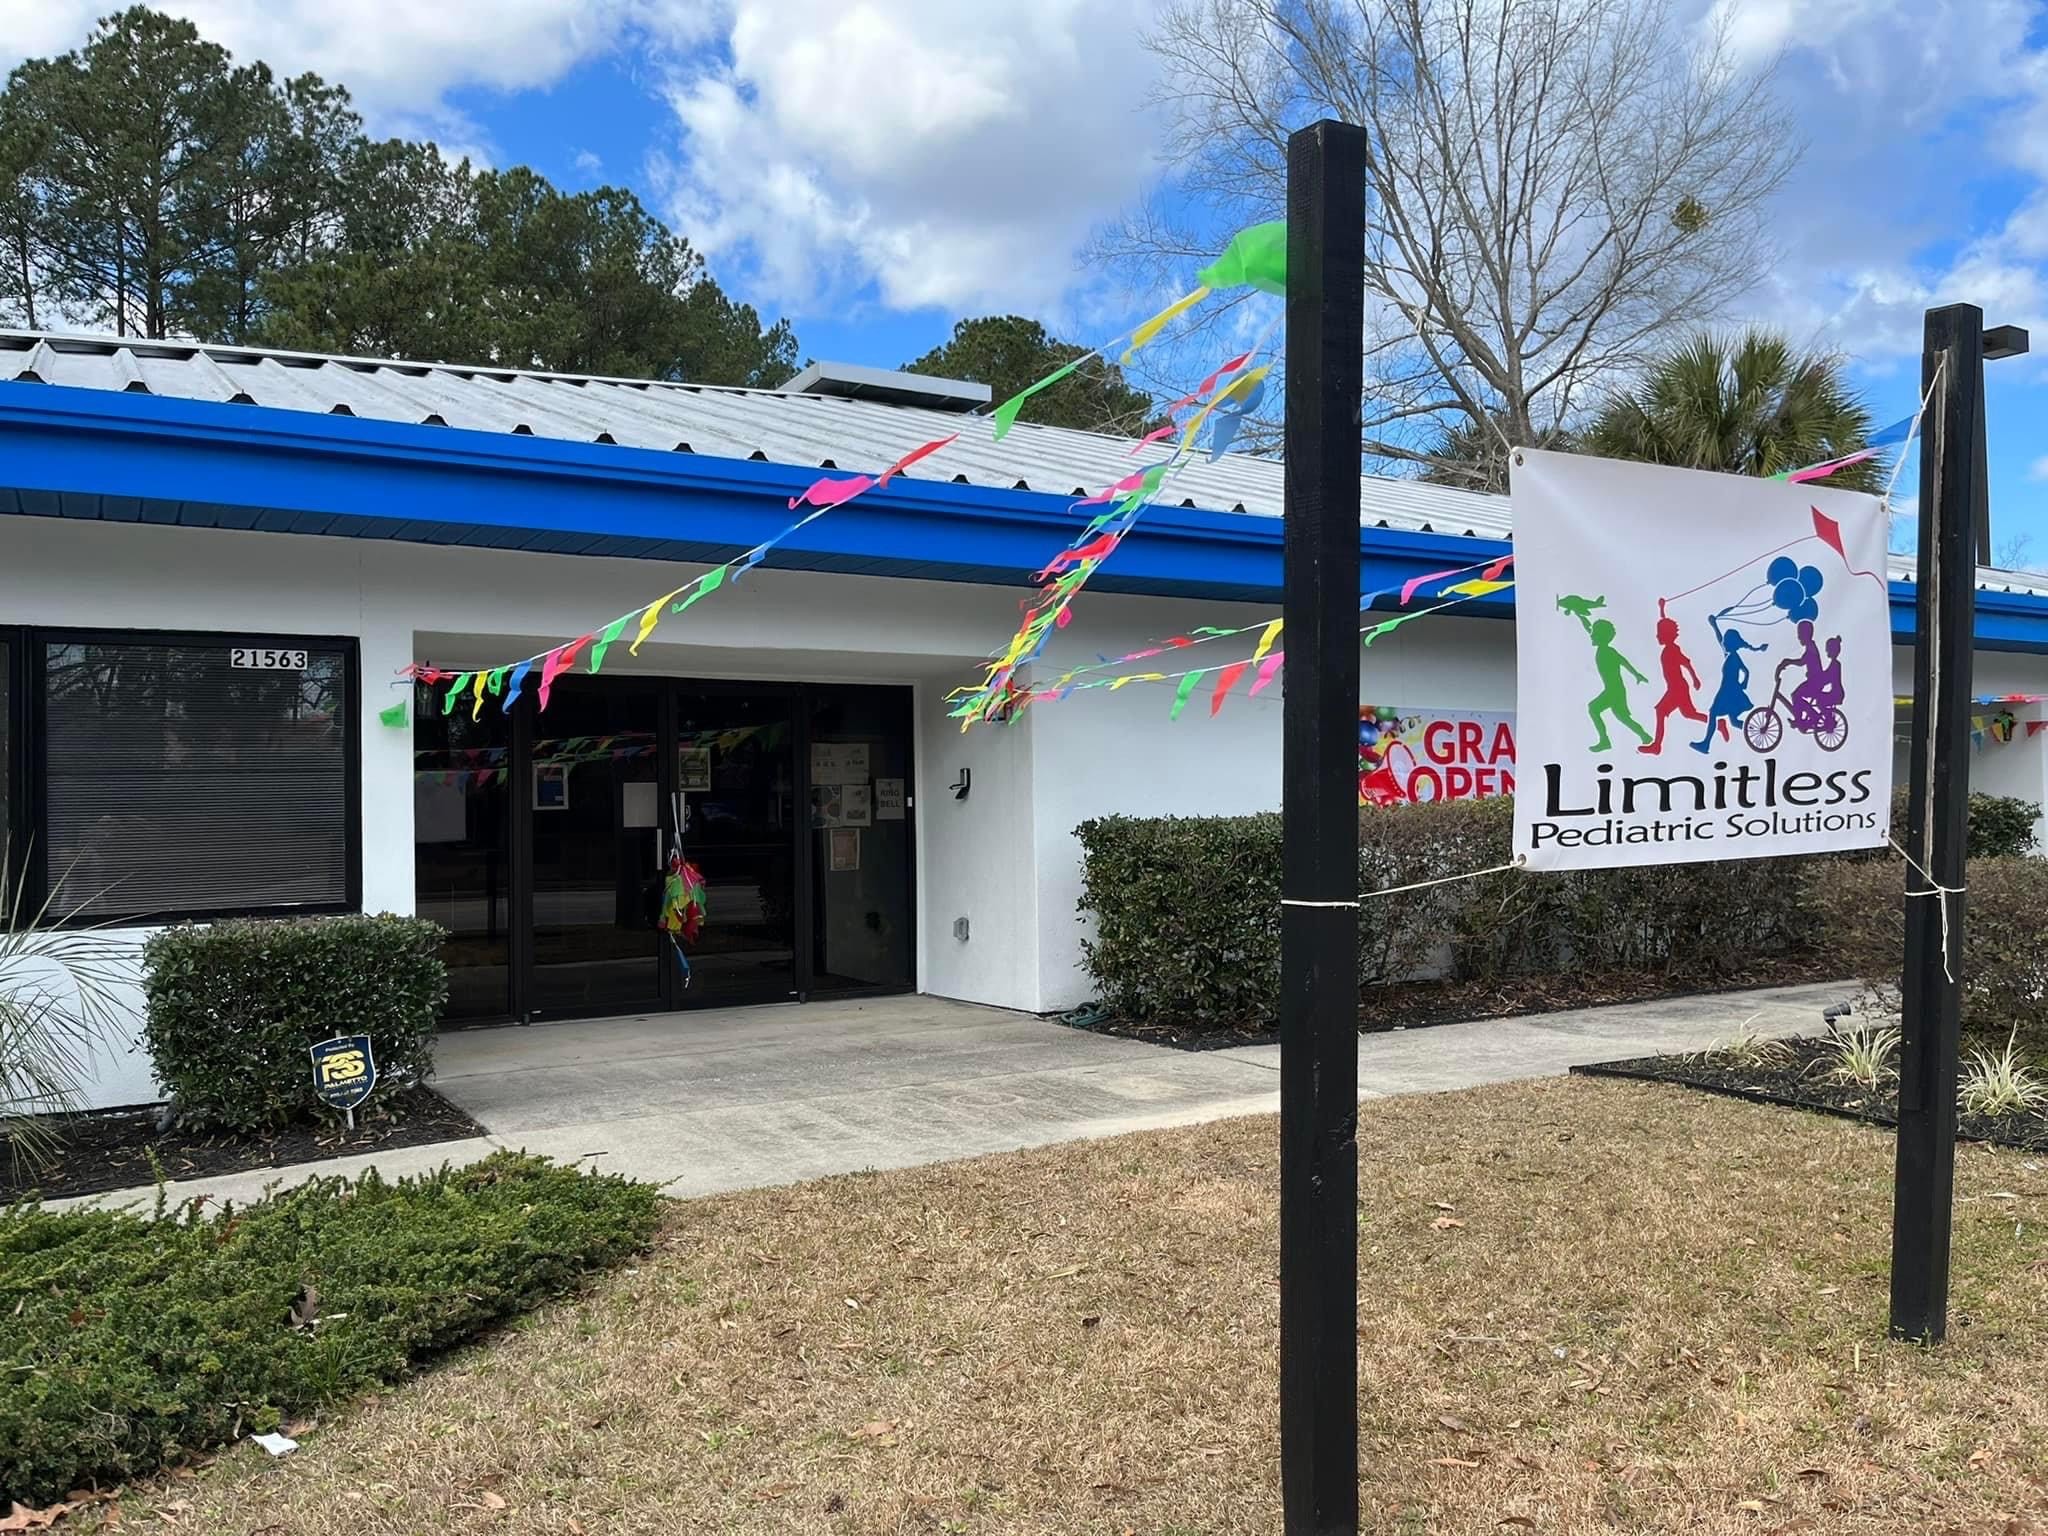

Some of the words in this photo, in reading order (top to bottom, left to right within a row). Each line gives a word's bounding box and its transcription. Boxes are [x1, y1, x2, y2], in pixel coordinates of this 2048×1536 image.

[233, 649, 306, 668] 21563
[1543, 758, 1872, 818] Limitless
[1530, 817, 1714, 849] Pediatric
[1725, 809, 1876, 838] Solutions
